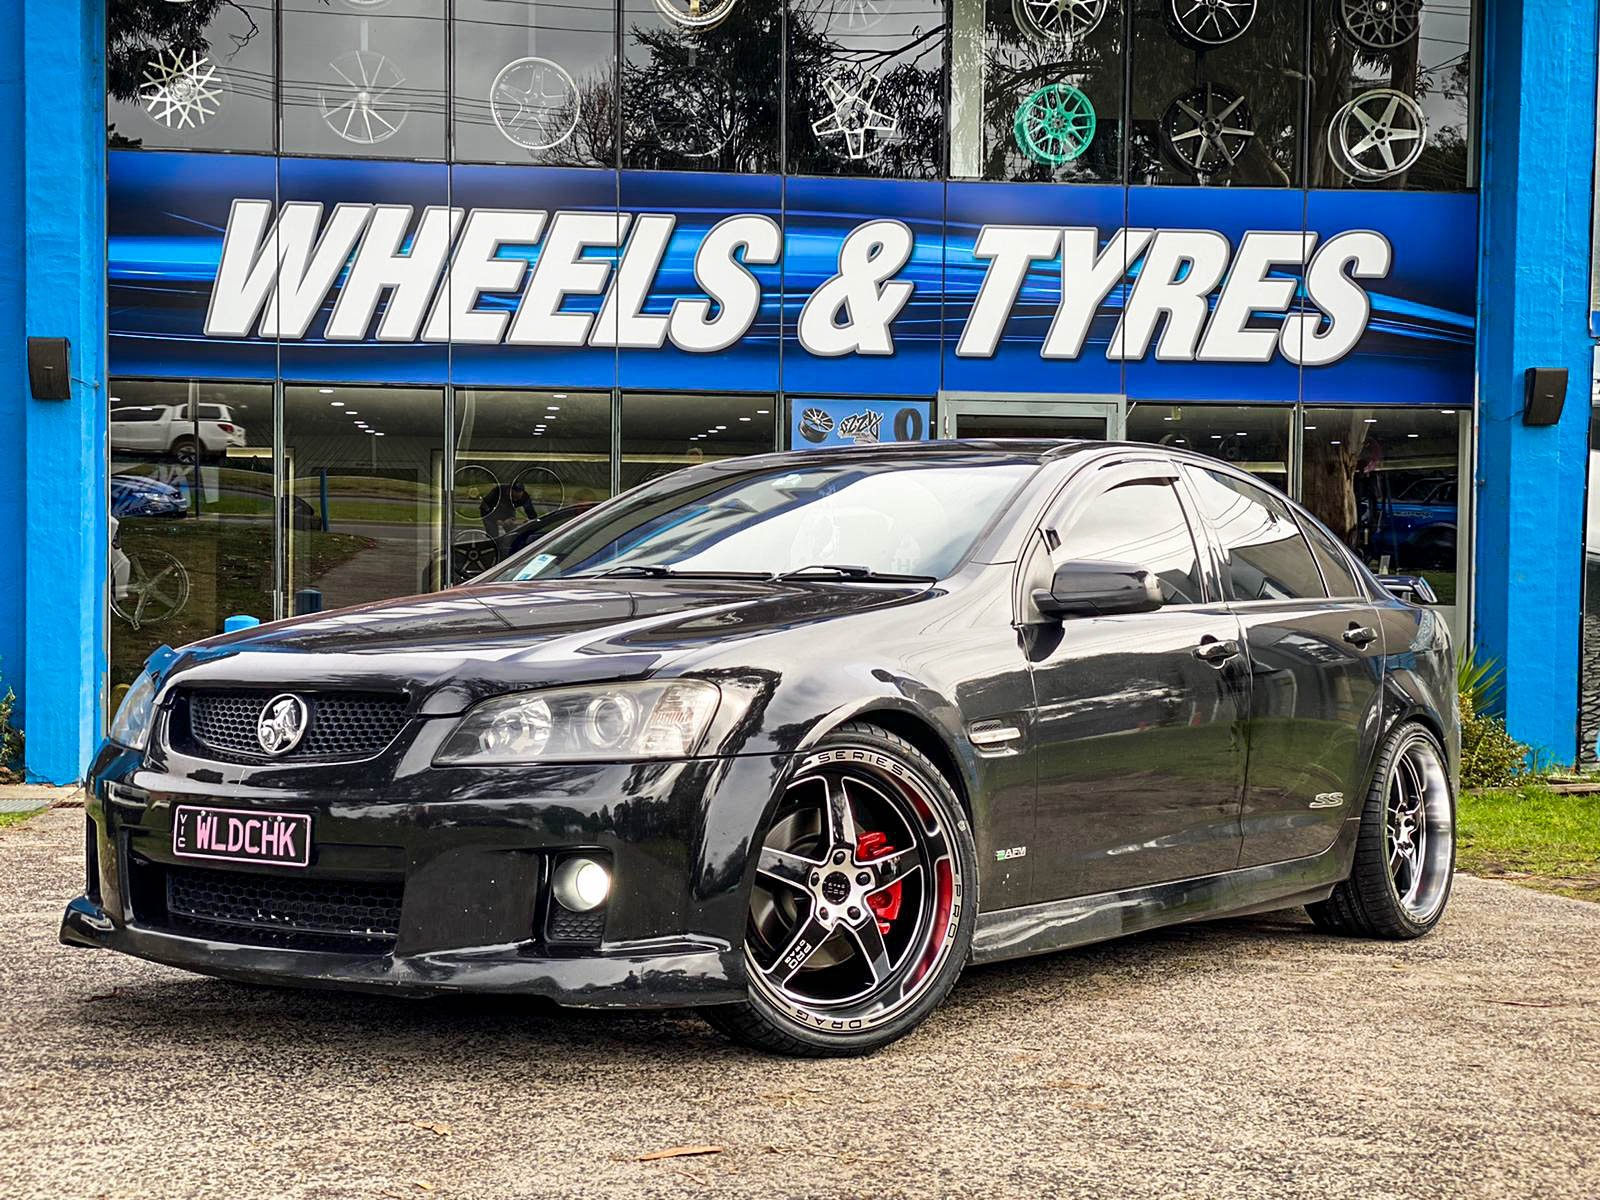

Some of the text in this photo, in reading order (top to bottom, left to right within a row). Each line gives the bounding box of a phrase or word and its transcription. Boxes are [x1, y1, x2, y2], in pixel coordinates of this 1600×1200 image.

[203, 198, 1392, 366] WHEELS & TYRES
[817, 750, 904, 776] SERIES
[1308, 791, 1344, 809] SS
[177, 814, 188, 848] VIC
[196, 815, 298, 857] WLDCHK
[947, 883, 962, 938] PRO
[787, 942, 813, 970] PRO
[795, 1009, 862, 1029] DRAG
